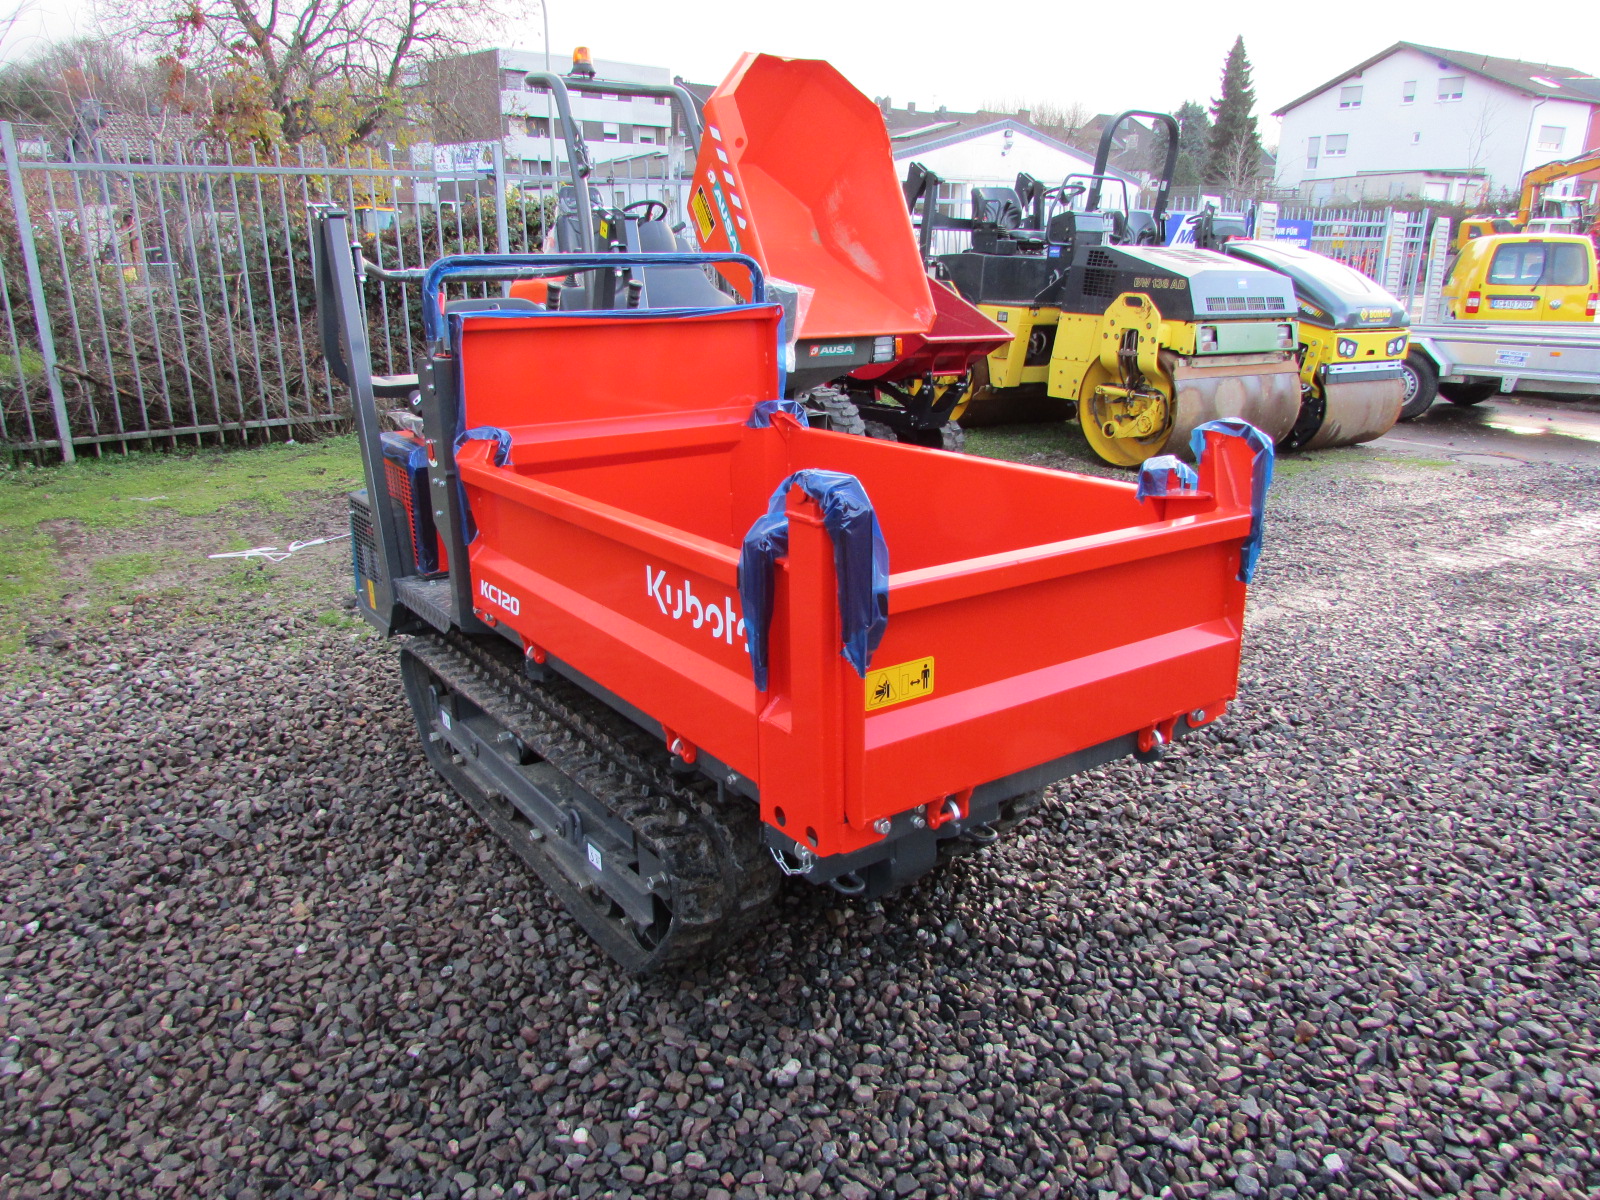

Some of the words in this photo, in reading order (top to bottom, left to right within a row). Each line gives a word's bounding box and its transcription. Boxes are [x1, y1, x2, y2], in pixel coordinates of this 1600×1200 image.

[713, 189, 738, 254] AUSA
[1170, 279, 1187, 290] AD
[820, 345, 853, 354] AUSA
[480, 579, 520, 616] KC120
